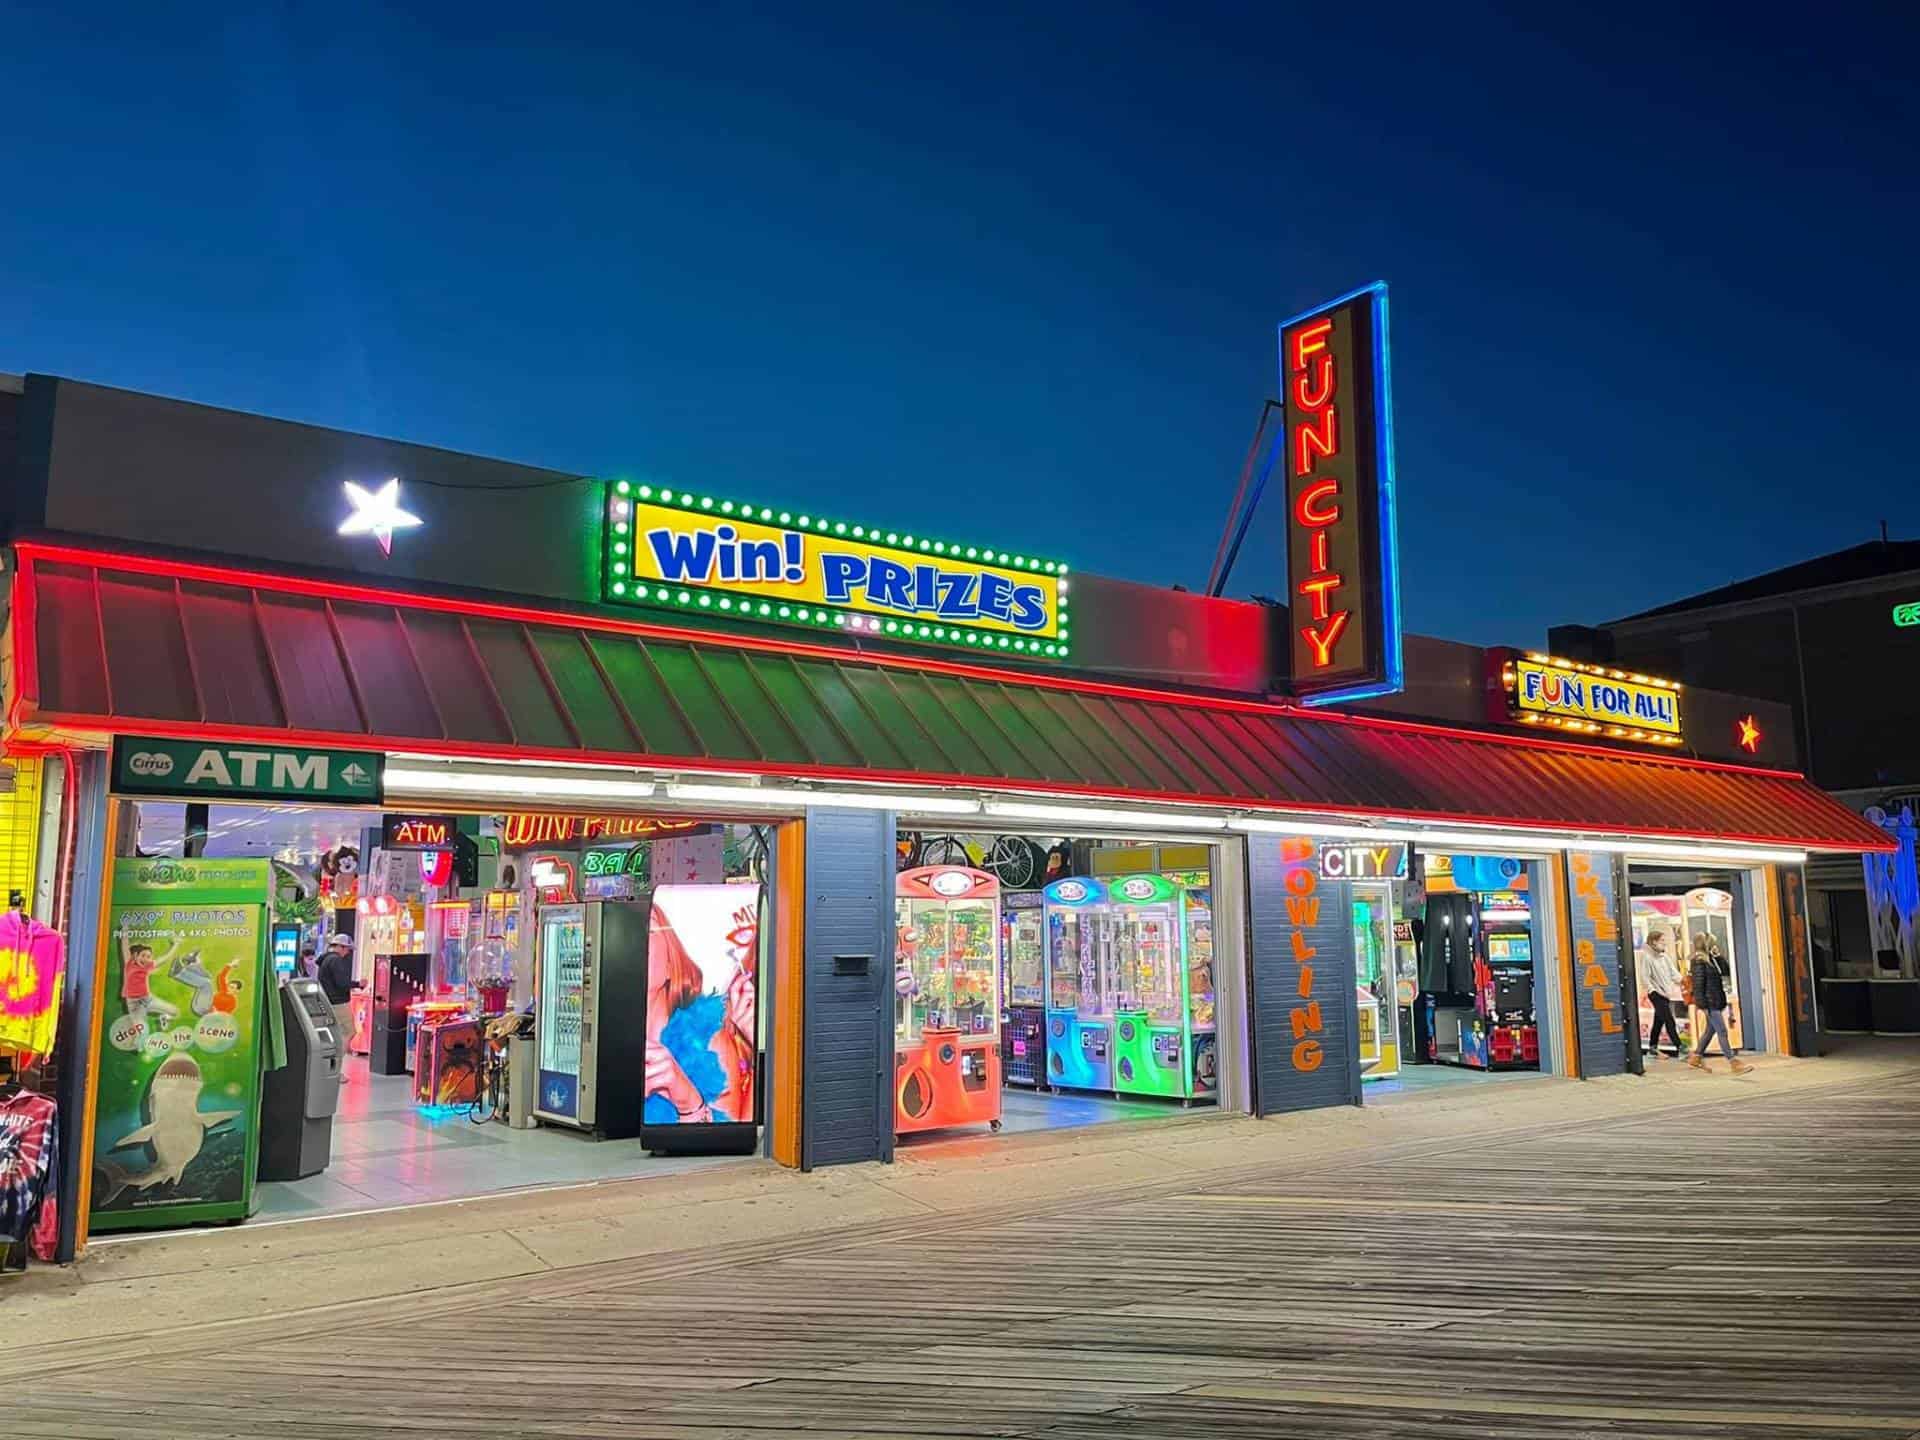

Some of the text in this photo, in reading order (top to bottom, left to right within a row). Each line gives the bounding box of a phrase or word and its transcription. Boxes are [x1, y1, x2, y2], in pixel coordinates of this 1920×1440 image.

[1292, 318, 1353, 668] FUN CITY
[646, 525, 1049, 631] Win! PRIZES
[1525, 671, 1674, 727] FUN FOR ALL!
[131, 757, 172, 771] Cirrus
[184, 749, 330, 790] ATM
[396, 821, 446, 845] ATM
[584, 851, 644, 877] BAL
[1324, 847, 1390, 877] CITY
[172, 910, 246, 926] PHOTOS
[213, 928, 251, 938] PHOTOS
[1280, 834, 1325, 1074] BOWLING
[1572, 853, 1625, 1035] SKEE BALL
[115, 1023, 144, 1042] drop
